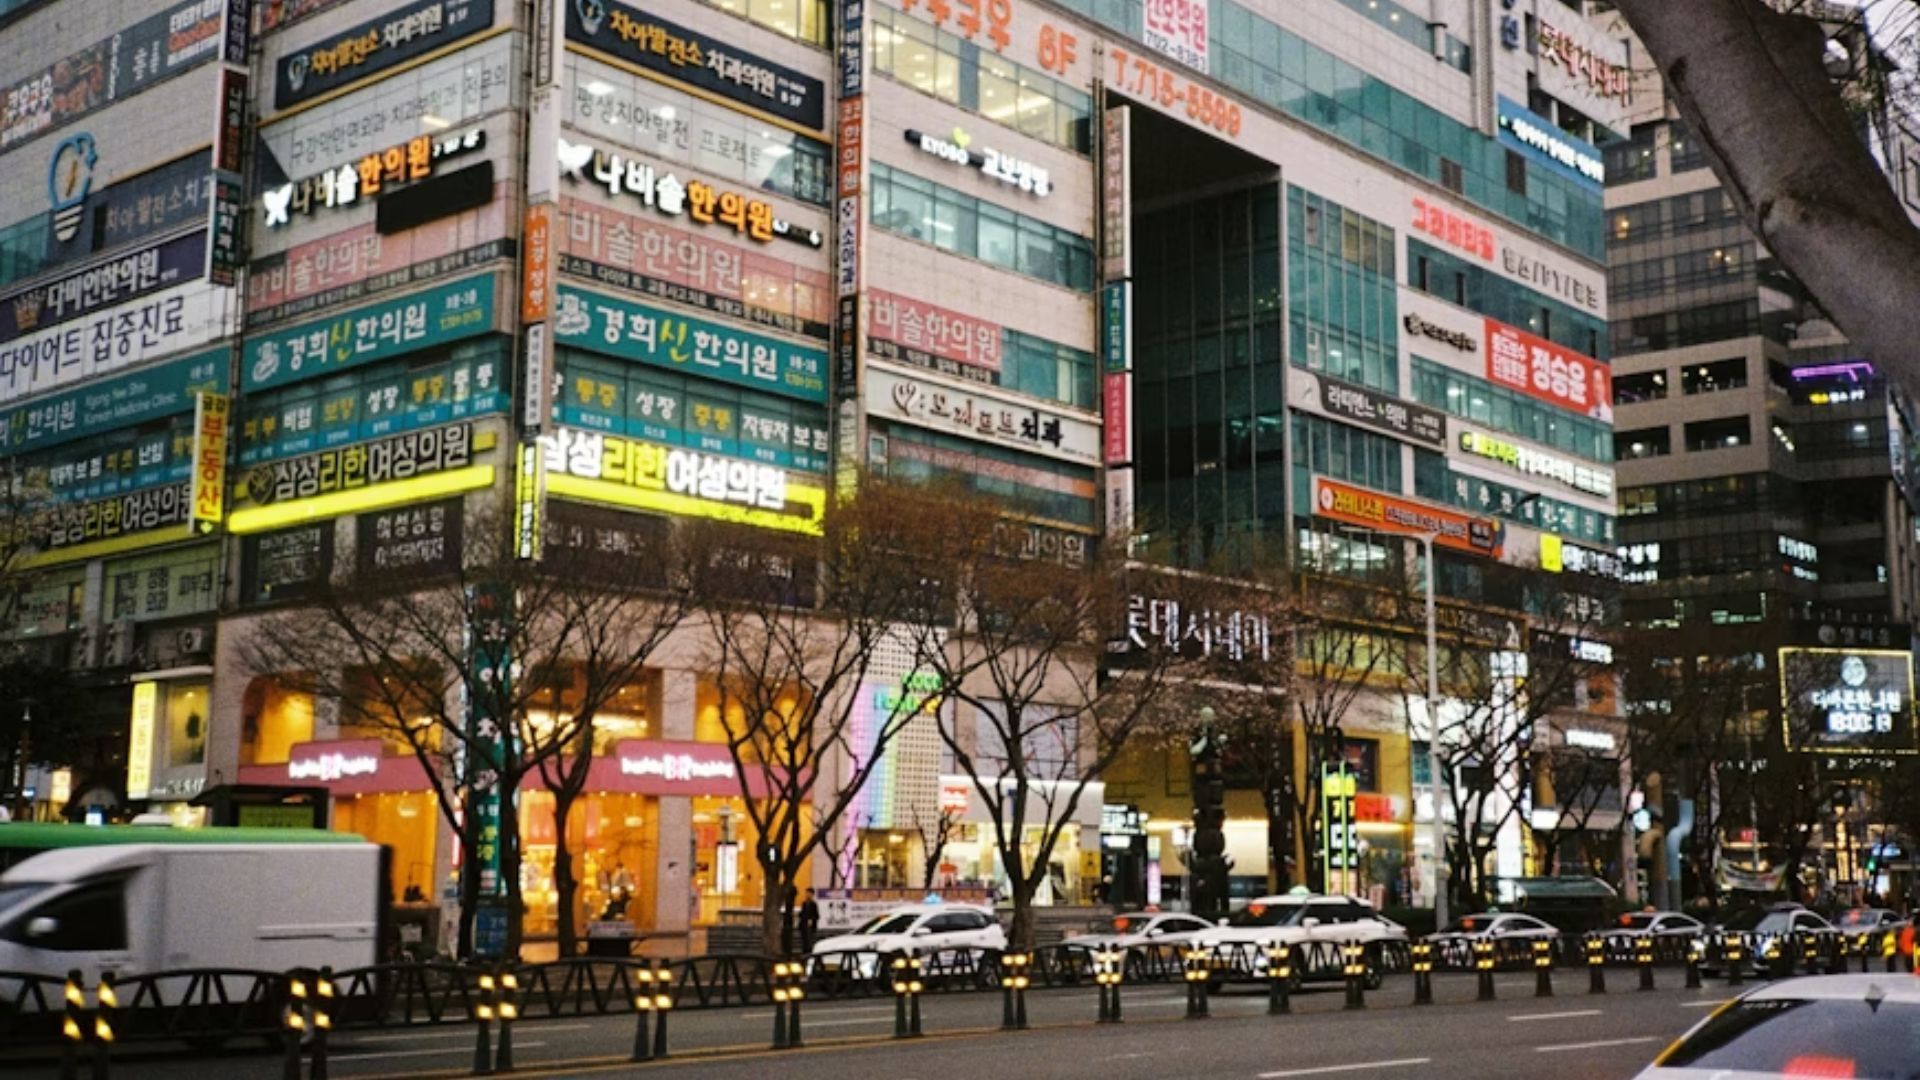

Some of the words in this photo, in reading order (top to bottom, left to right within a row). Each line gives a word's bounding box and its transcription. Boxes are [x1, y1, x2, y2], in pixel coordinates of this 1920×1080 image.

[310, 28, 380, 73] 치아발전소
[382, 5, 443, 47] 치과의원
[609, 10, 704, 65] 치아발전소
[706, 49, 777, 97] 치과의원
[1038, 22, 1078, 76] 6F
[291, 134, 432, 216] 나비솔한의원
[593, 151, 776, 242] 나비솔한의원
[47, 247, 159, 318] 다미인한의원
[248, 232, 384, 303] 나비솔한의원
[0, 327, 81, 389] 다이어트
[91, 294, 185, 363] 집중진료
[286, 301, 427, 371] 경희신한의원
[596, 304, 778, 382] 경희신한의원
[367, 386, 399, 413] 성장
[635, 391, 677, 420] 성장
[1530, 345, 1588, 406] 정승윤
[274, 423, 471, 501] 삼성리한여성의원
[743, 413, 790, 444] 자동차
[197, 414, 221, 516] 부동산
[533, 427, 785, 509] 삼성리한여성의원
